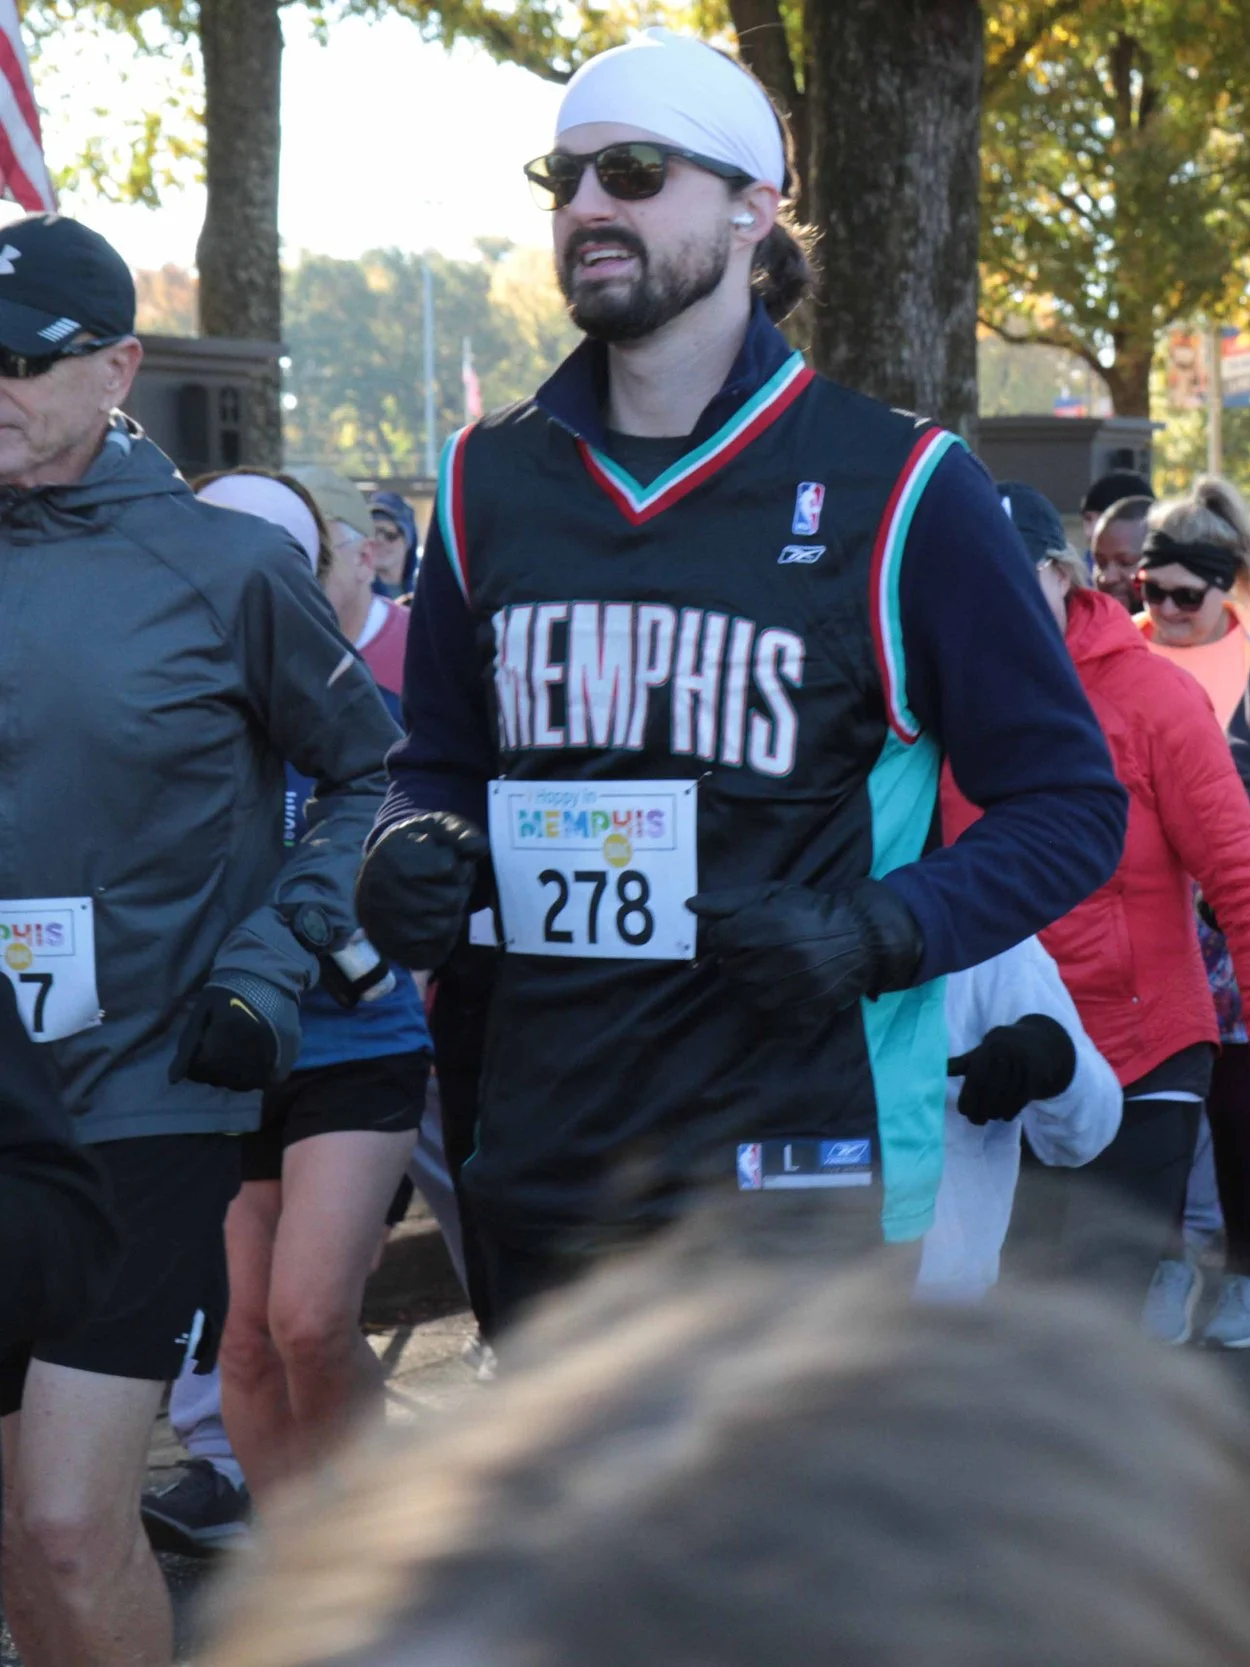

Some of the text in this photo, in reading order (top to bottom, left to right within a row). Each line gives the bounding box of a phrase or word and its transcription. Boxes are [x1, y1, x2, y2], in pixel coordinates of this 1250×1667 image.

[492, 600, 806, 777] MEMPHIS
[518, 809, 666, 838] MEMPHIS
[537, 868, 656, 946] 278
[783, 1144, 800, 1172] L
